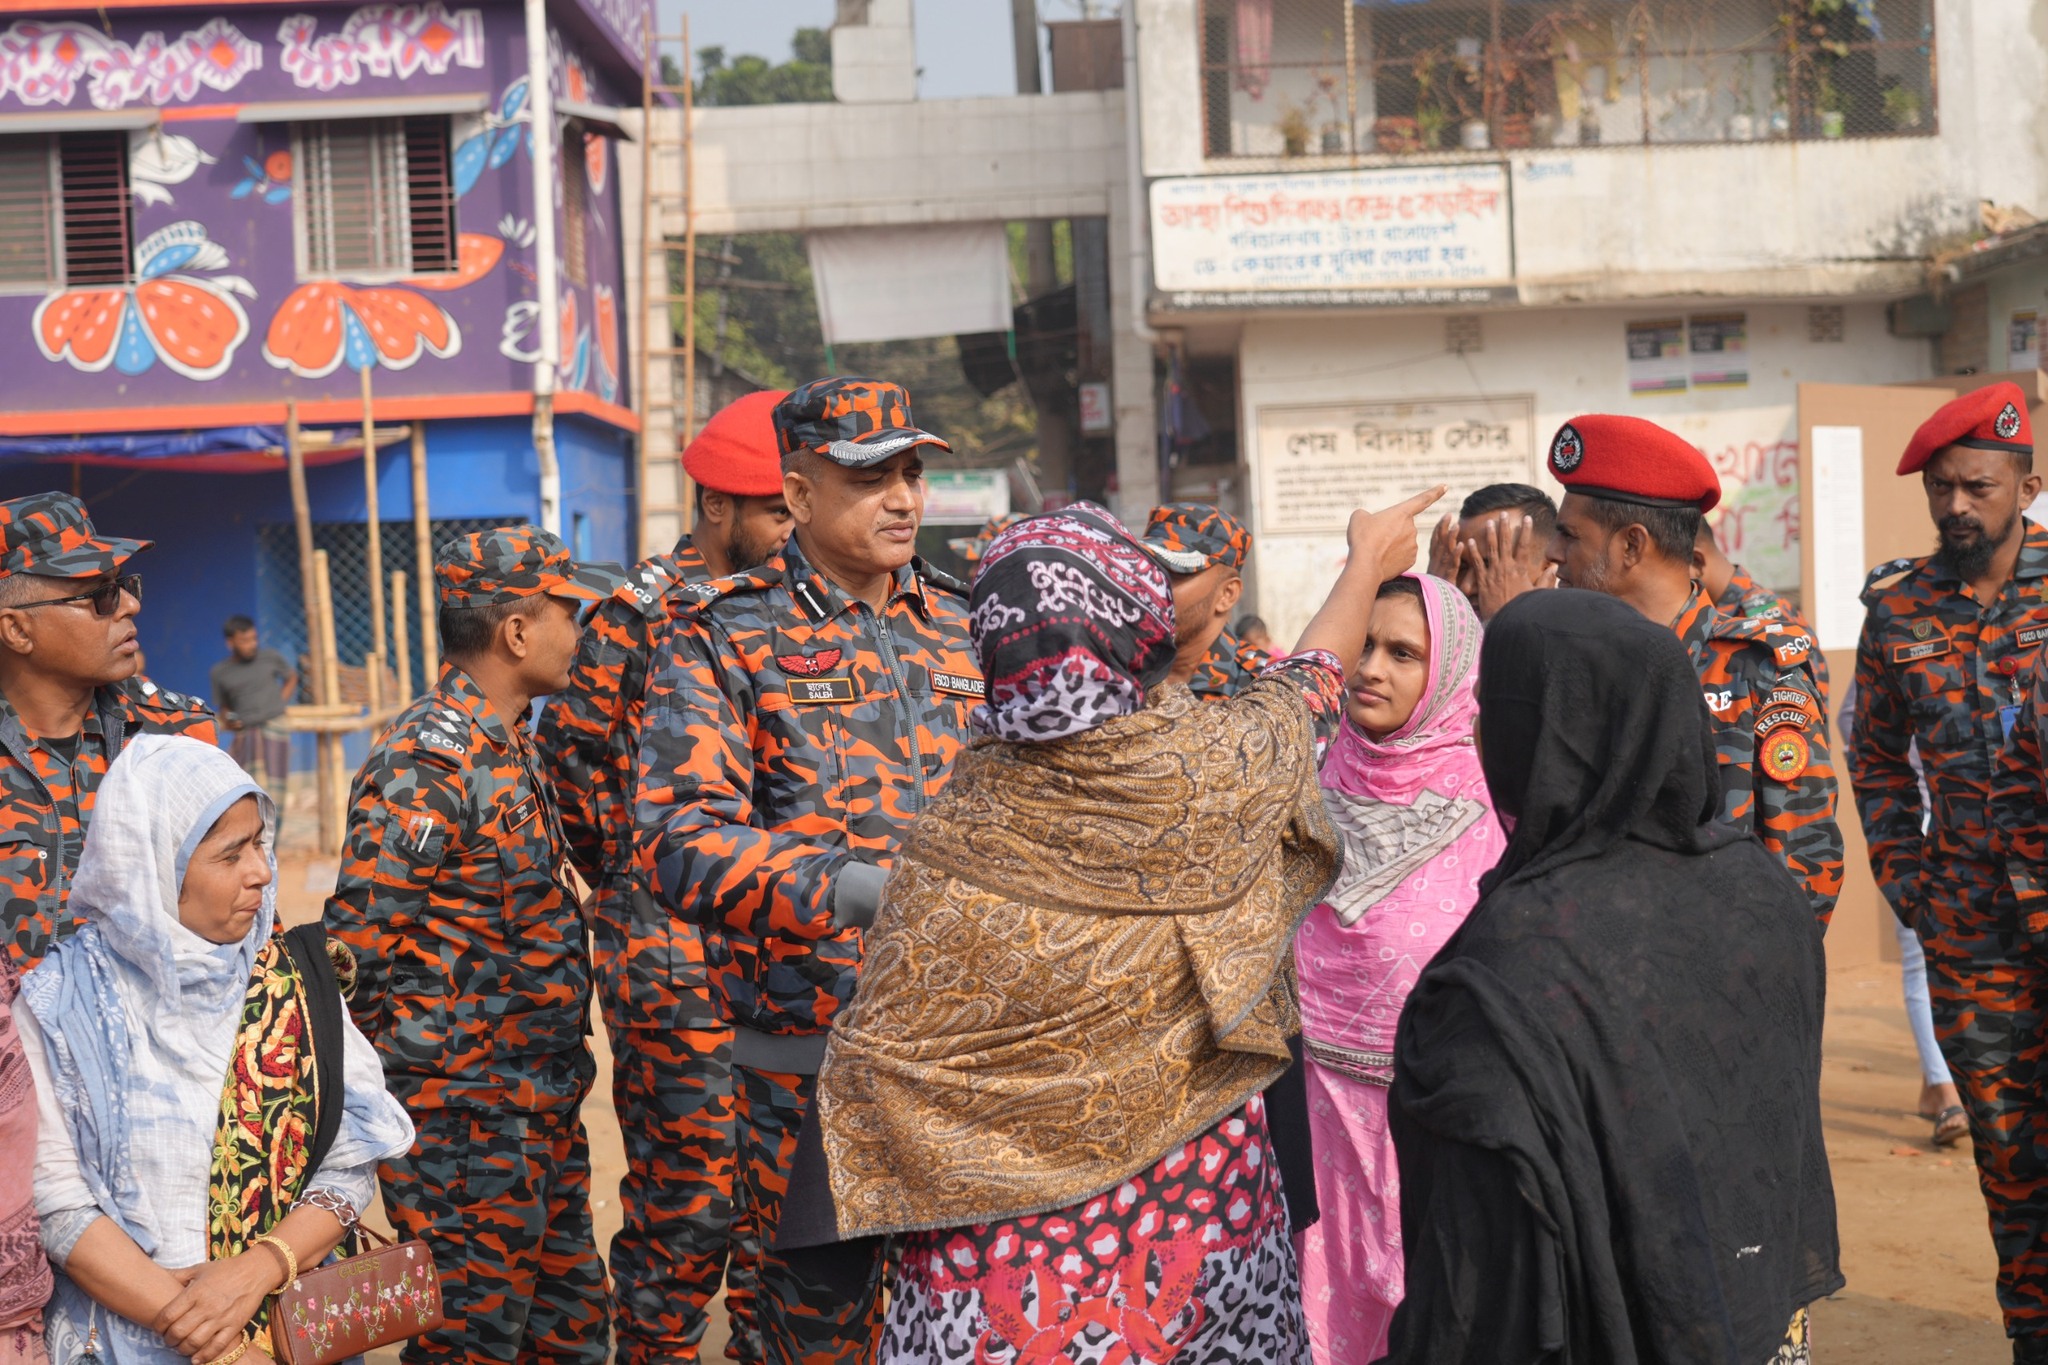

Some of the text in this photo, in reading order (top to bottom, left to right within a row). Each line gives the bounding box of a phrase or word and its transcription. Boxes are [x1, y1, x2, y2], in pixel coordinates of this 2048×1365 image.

[623, 581, 653, 604] SCD
[1778, 634, 1812, 662] FSCD
[808, 691, 834, 699] SALEH
[950, 676, 985, 694] BANGLADES
[1704, 690, 1733, 712] RE
[1772, 690, 1807, 707] FIGHTER
[1756, 710, 1807, 733] RESCUE
[418, 730, 466, 755] FSCD
[337, 1256, 381, 1279] GUESS
